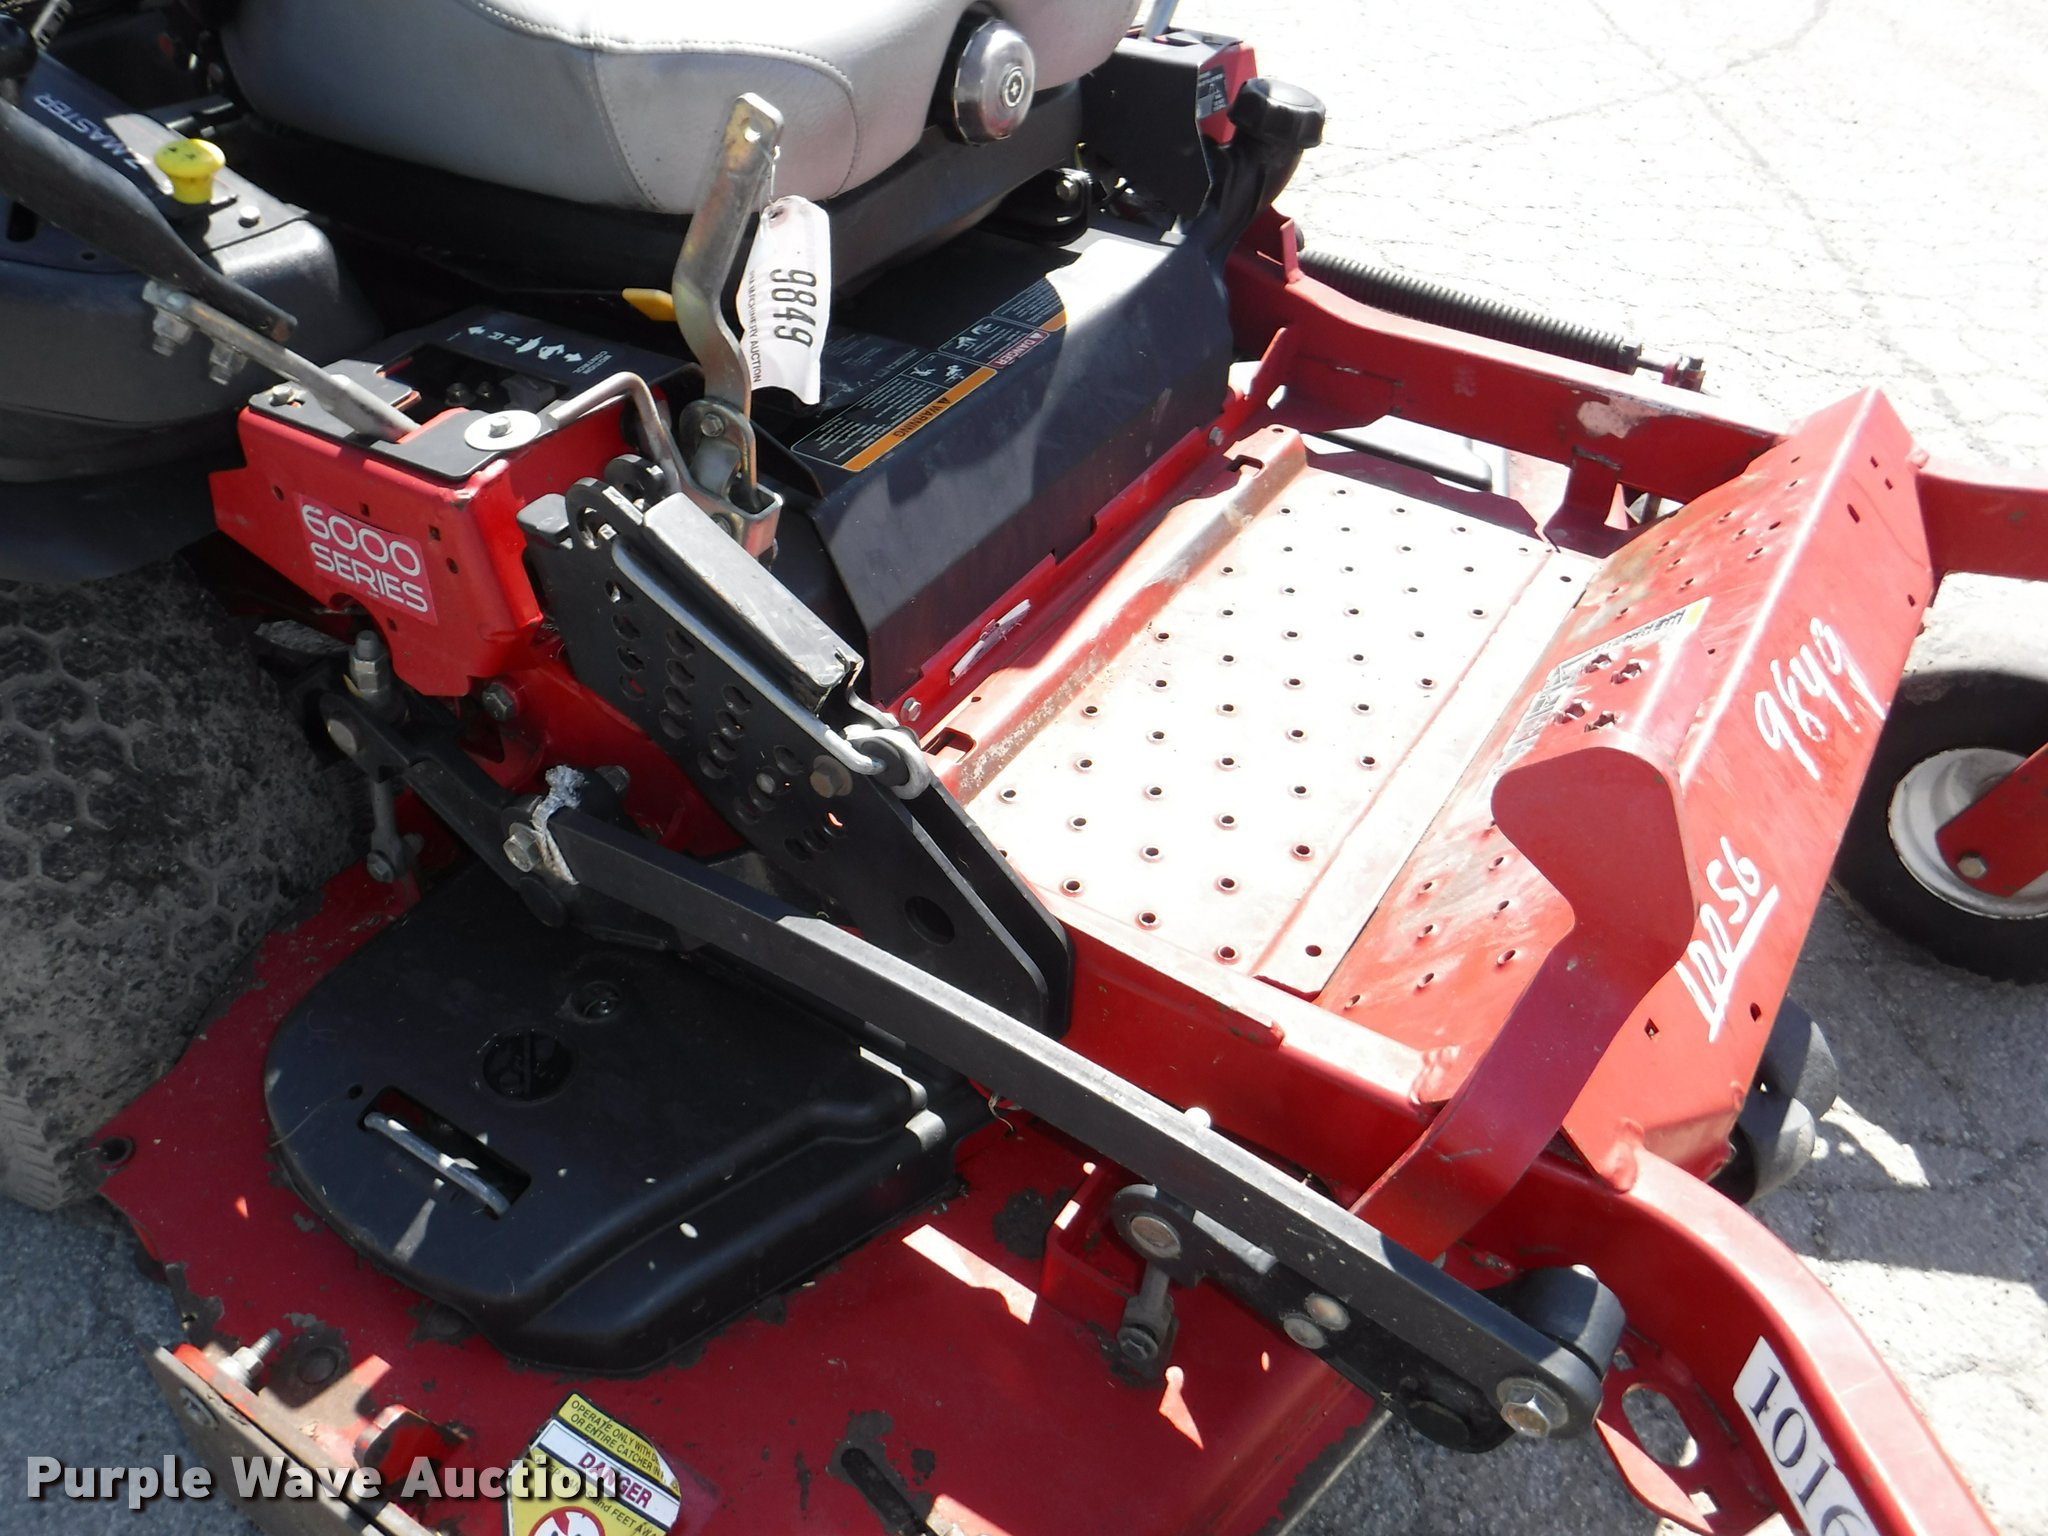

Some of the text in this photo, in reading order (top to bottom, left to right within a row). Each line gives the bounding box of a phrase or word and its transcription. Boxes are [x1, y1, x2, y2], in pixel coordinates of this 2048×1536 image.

[34, 94, 128, 156] MASTER
[487, 331, 505, 341] R
[769, 268, 817, 348] 9849
[750, 340, 762, 383] AUCTION
[995, 338, 1036, 366] DANGER
[893, 399, 945, 437] WARNING
[302, 504, 421, 577] 6000
[310, 541, 428, 613] SERIES
[570, 1413, 584, 1427] OR
[584, 1423, 616, 1449] ENTIRE
[617, 1443, 653, 1471] CATCHER
[571, 1400, 651, 1457] OPERATE ONLY WITH
[578, 1452, 653, 1509] DANGER
[611, 1508, 637, 1527] FEET
